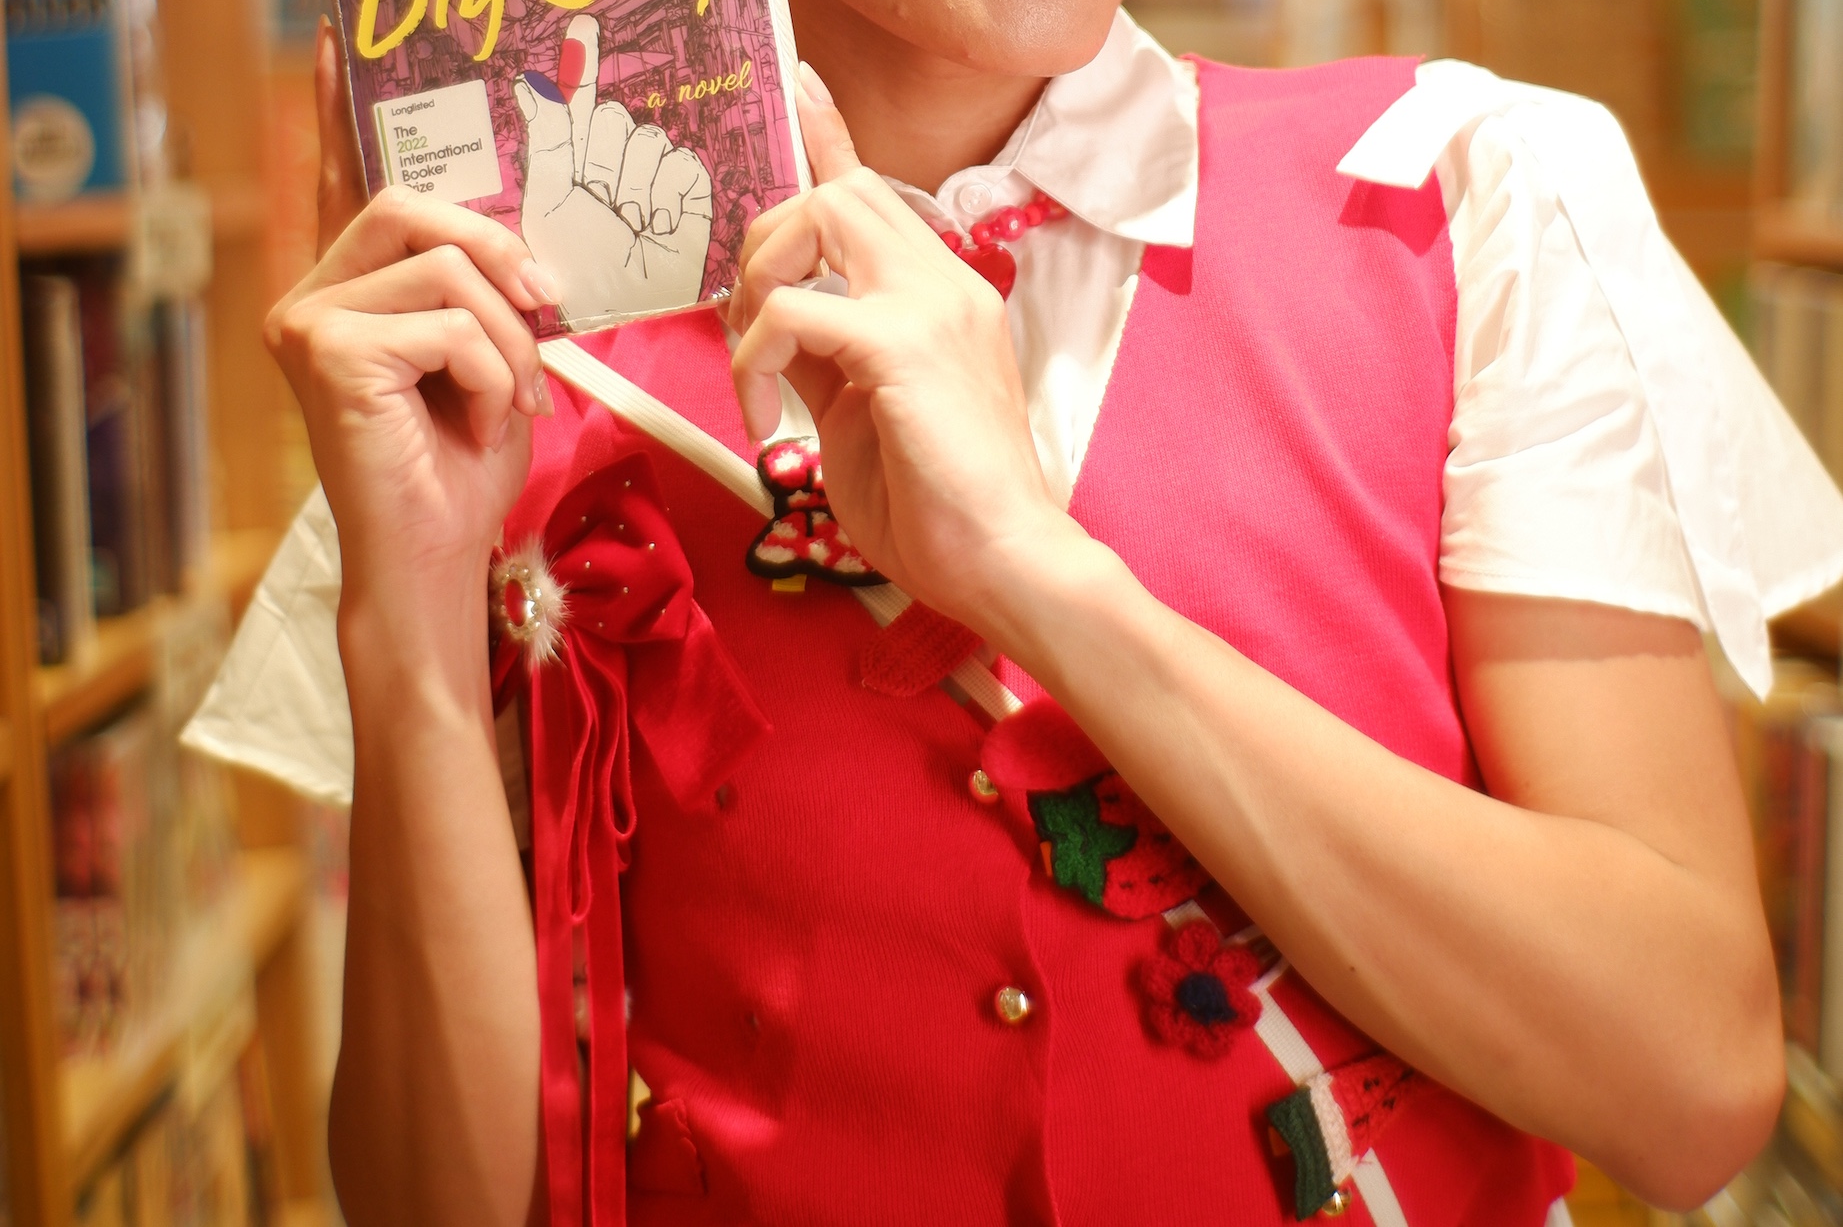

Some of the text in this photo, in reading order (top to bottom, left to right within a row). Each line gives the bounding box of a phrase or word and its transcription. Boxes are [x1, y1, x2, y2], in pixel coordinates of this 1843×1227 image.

[647, 60, 754, 108] a novel
[391, 98, 436, 117] Longlisted
[393, 125, 418, 140] The
[396, 135, 429, 154] 2022
[398, 137, 483, 168] International
[402, 162, 448, 183] Booker
